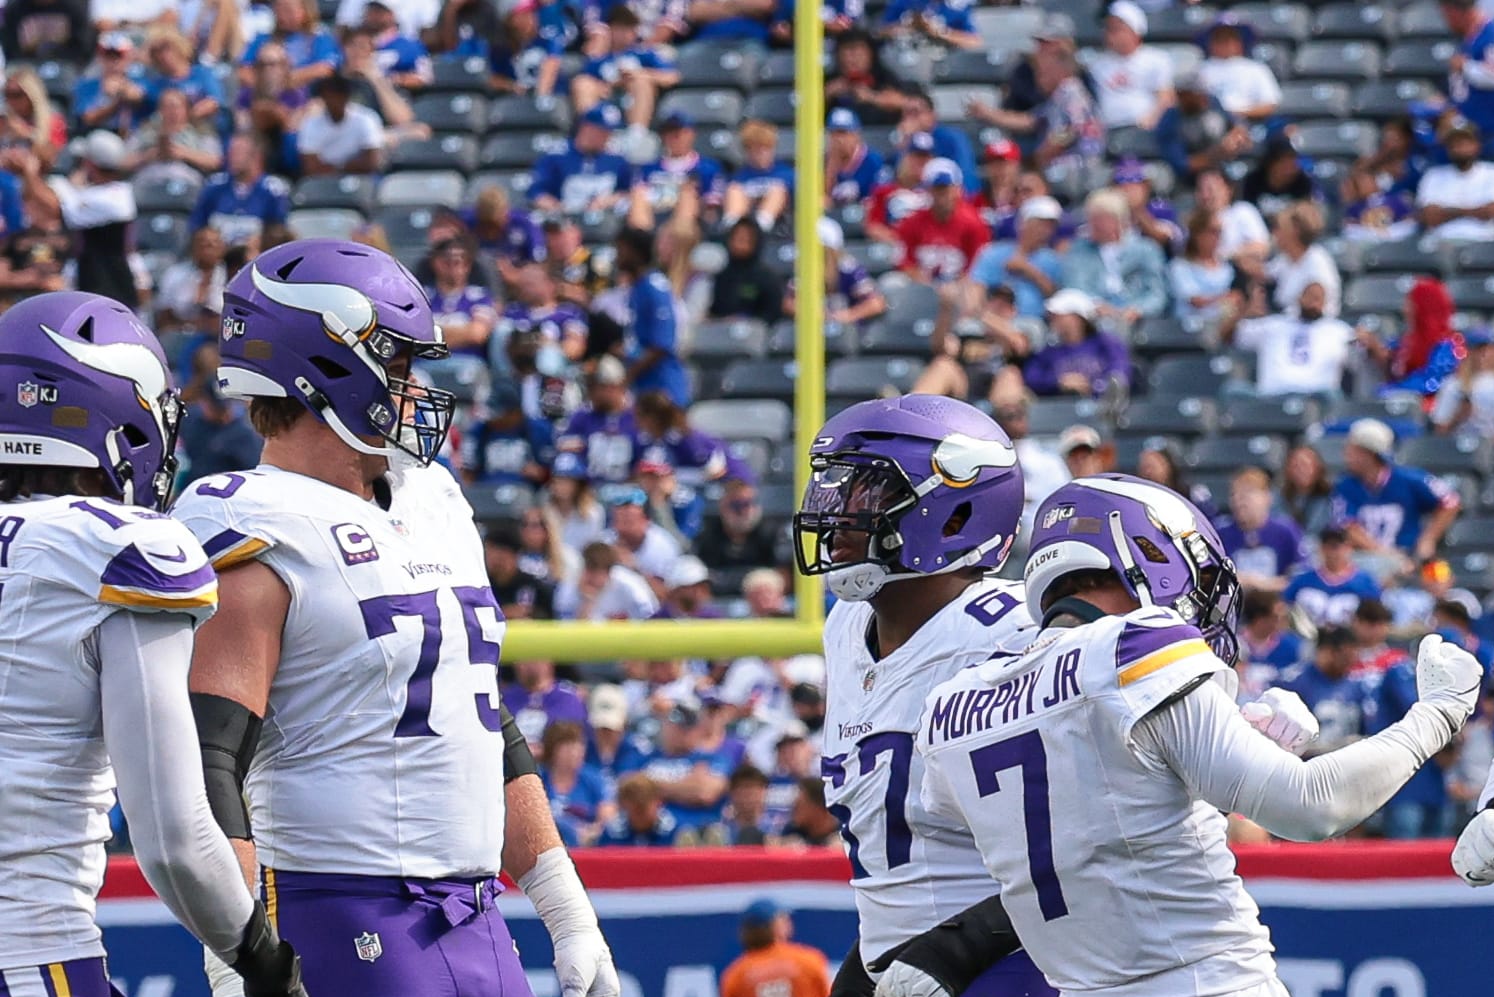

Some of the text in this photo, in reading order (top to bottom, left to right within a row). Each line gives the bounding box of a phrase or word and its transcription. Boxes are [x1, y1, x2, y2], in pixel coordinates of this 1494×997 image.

[234, 321, 246, 335] KJ
[41, 387, 58, 402] KJ
[4, 441, 43, 455] HATE
[1035, 549, 1059, 567] LOVE
[359, 585, 505, 738] 75
[928, 647, 1082, 746] MURPHY JR
[969, 728, 1070, 923] 7
